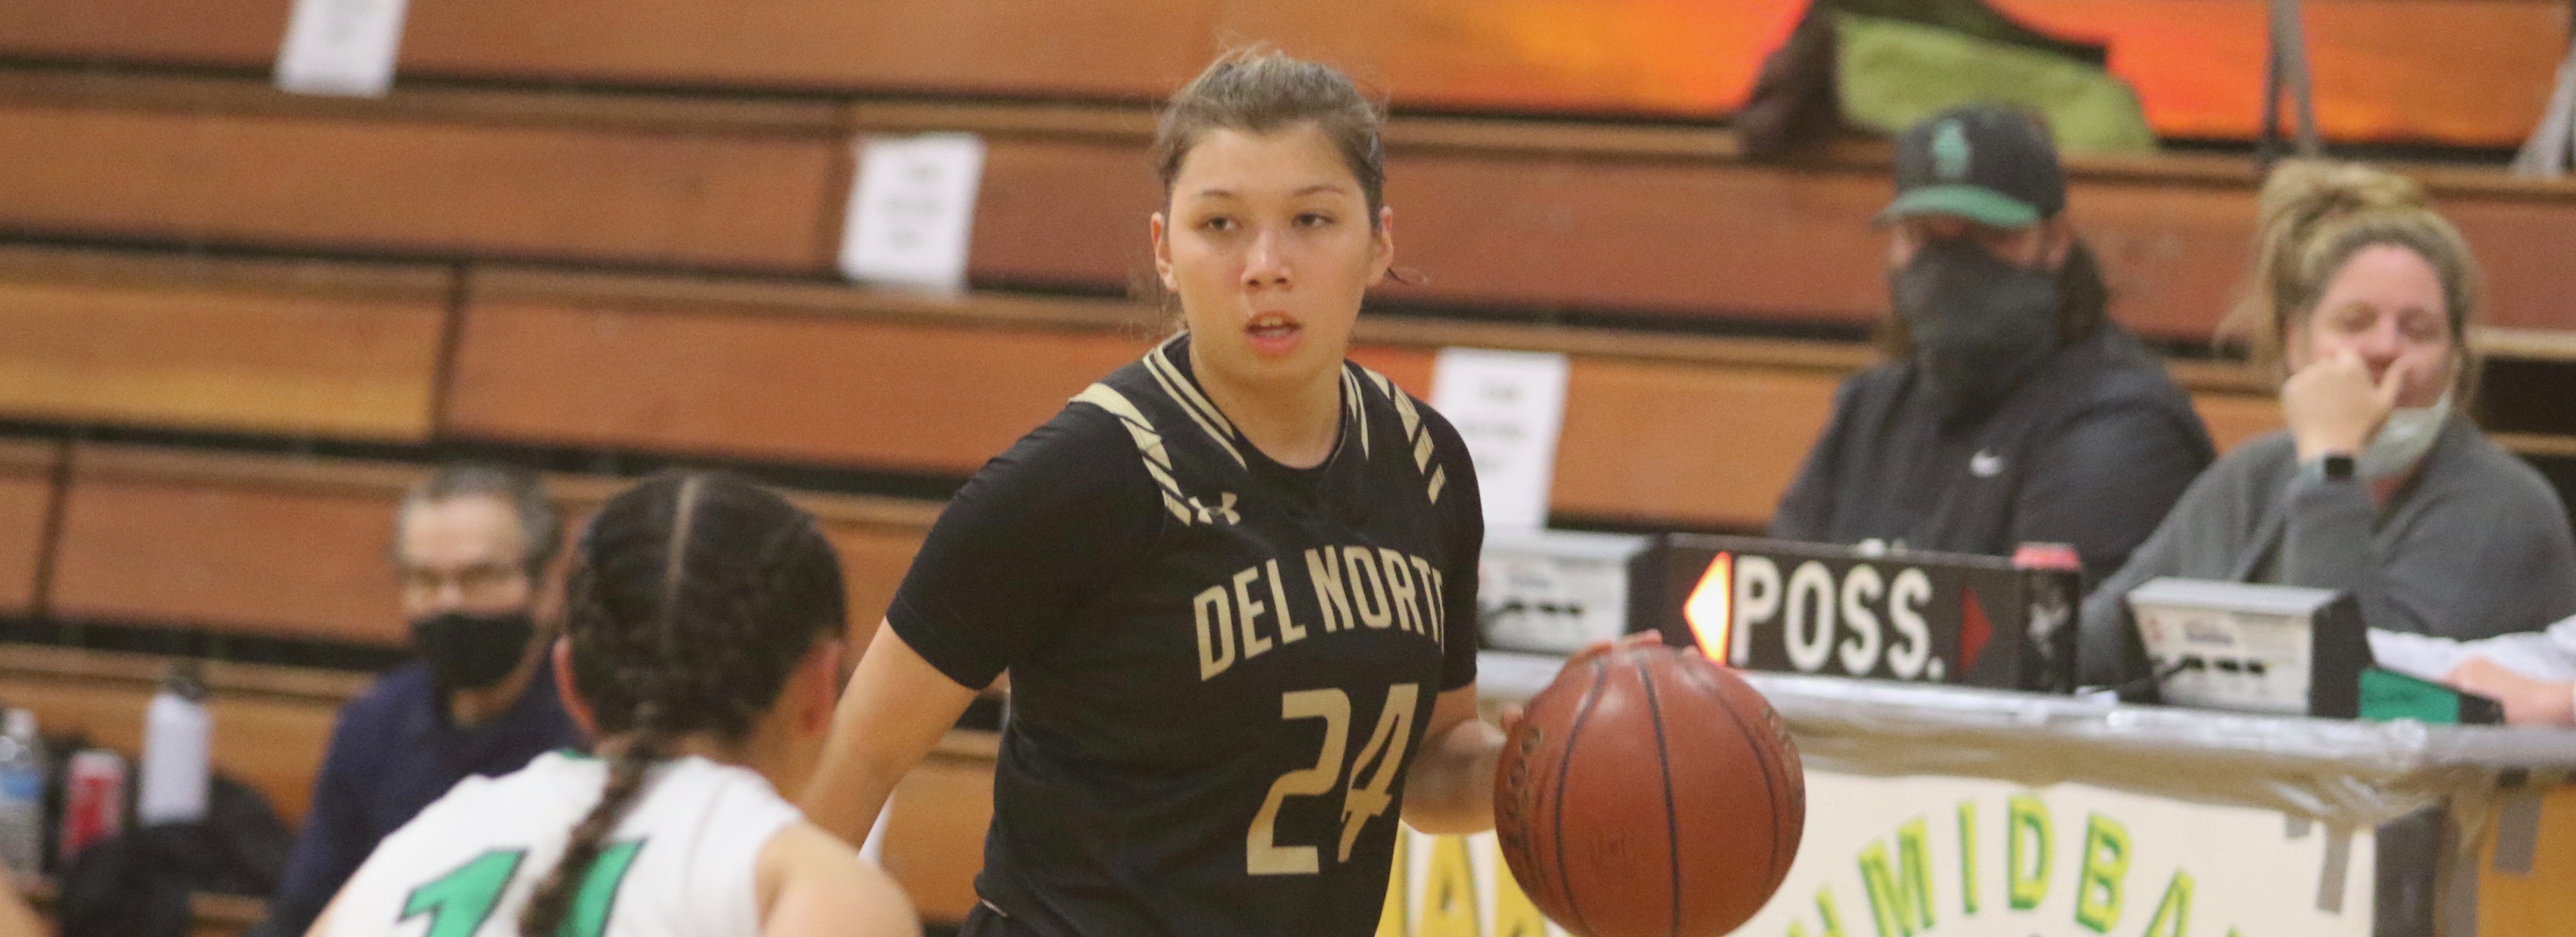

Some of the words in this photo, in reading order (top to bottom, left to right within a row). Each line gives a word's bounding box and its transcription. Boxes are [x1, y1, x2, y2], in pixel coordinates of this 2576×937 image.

[1193, 559, 1307, 681] DEL
[1729, 555, 1946, 680] POSS.
[1247, 683, 1419, 876] 24
